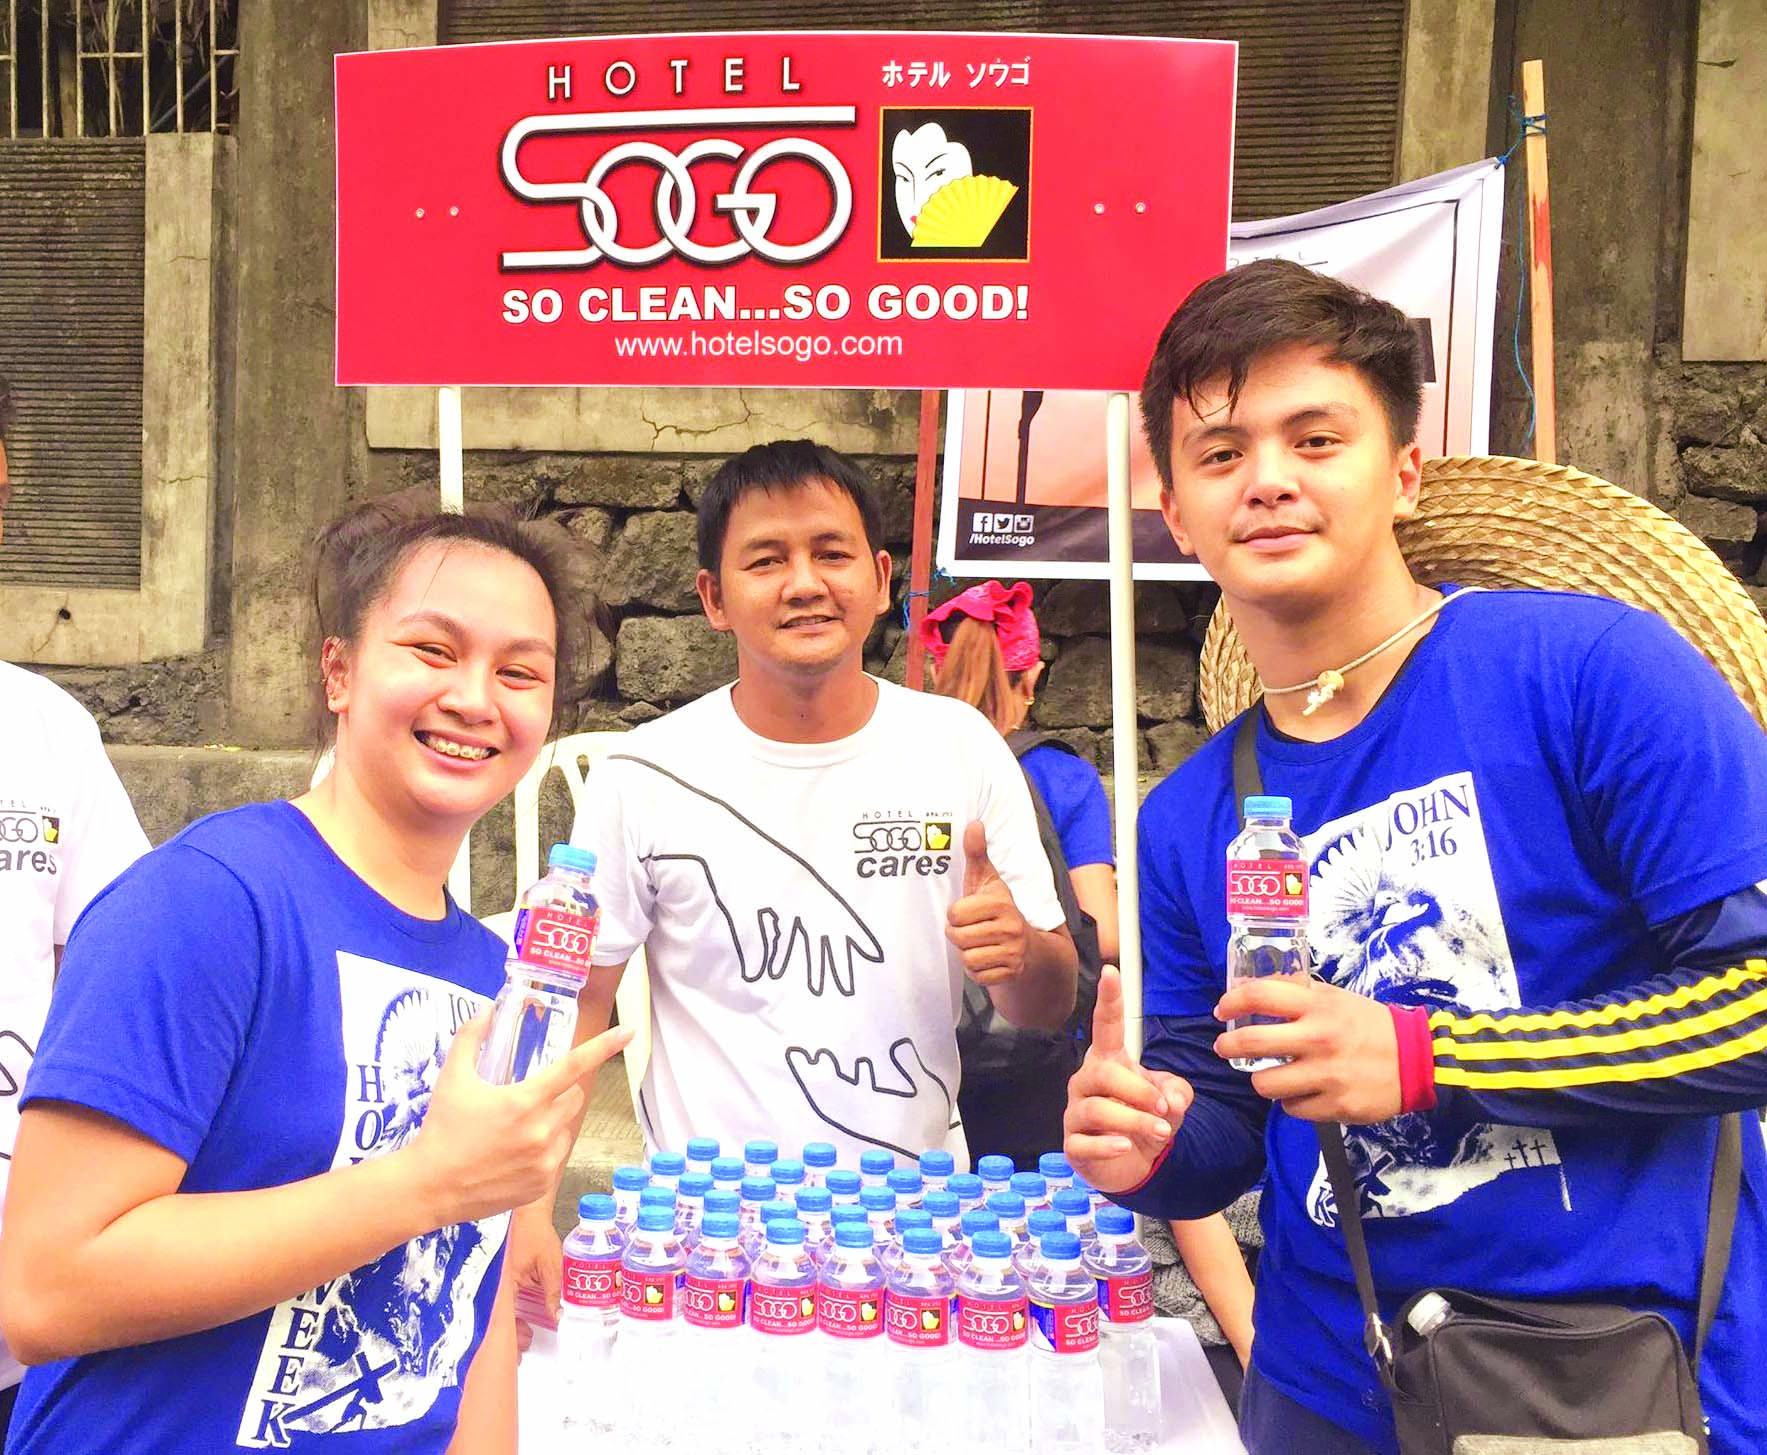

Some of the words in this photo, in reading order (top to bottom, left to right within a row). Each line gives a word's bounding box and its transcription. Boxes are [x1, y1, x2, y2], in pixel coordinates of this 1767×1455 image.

[547, 57, 801, 100] HOTEL
[881, 59, 951, 89] ホテル
[966, 56, 1031, 89] ソウゴ
[499, 105, 857, 269] SOGO
[502, 289, 563, 324] SO
[867, 284, 1029, 321] GOOD!
[614, 329, 903, 362] www.hotelsogo.com
[969, 533, 1035, 548] /HotelSogo
[862, 810, 913, 820] HOTEL
[1385, 784, 1471, 851] JOHN
[853, 820, 922, 853] SOGO
[1410, 826, 1458, 867] 3:16
[856, 855, 952, 878] cares
[532, 919, 592, 955] SOGO
